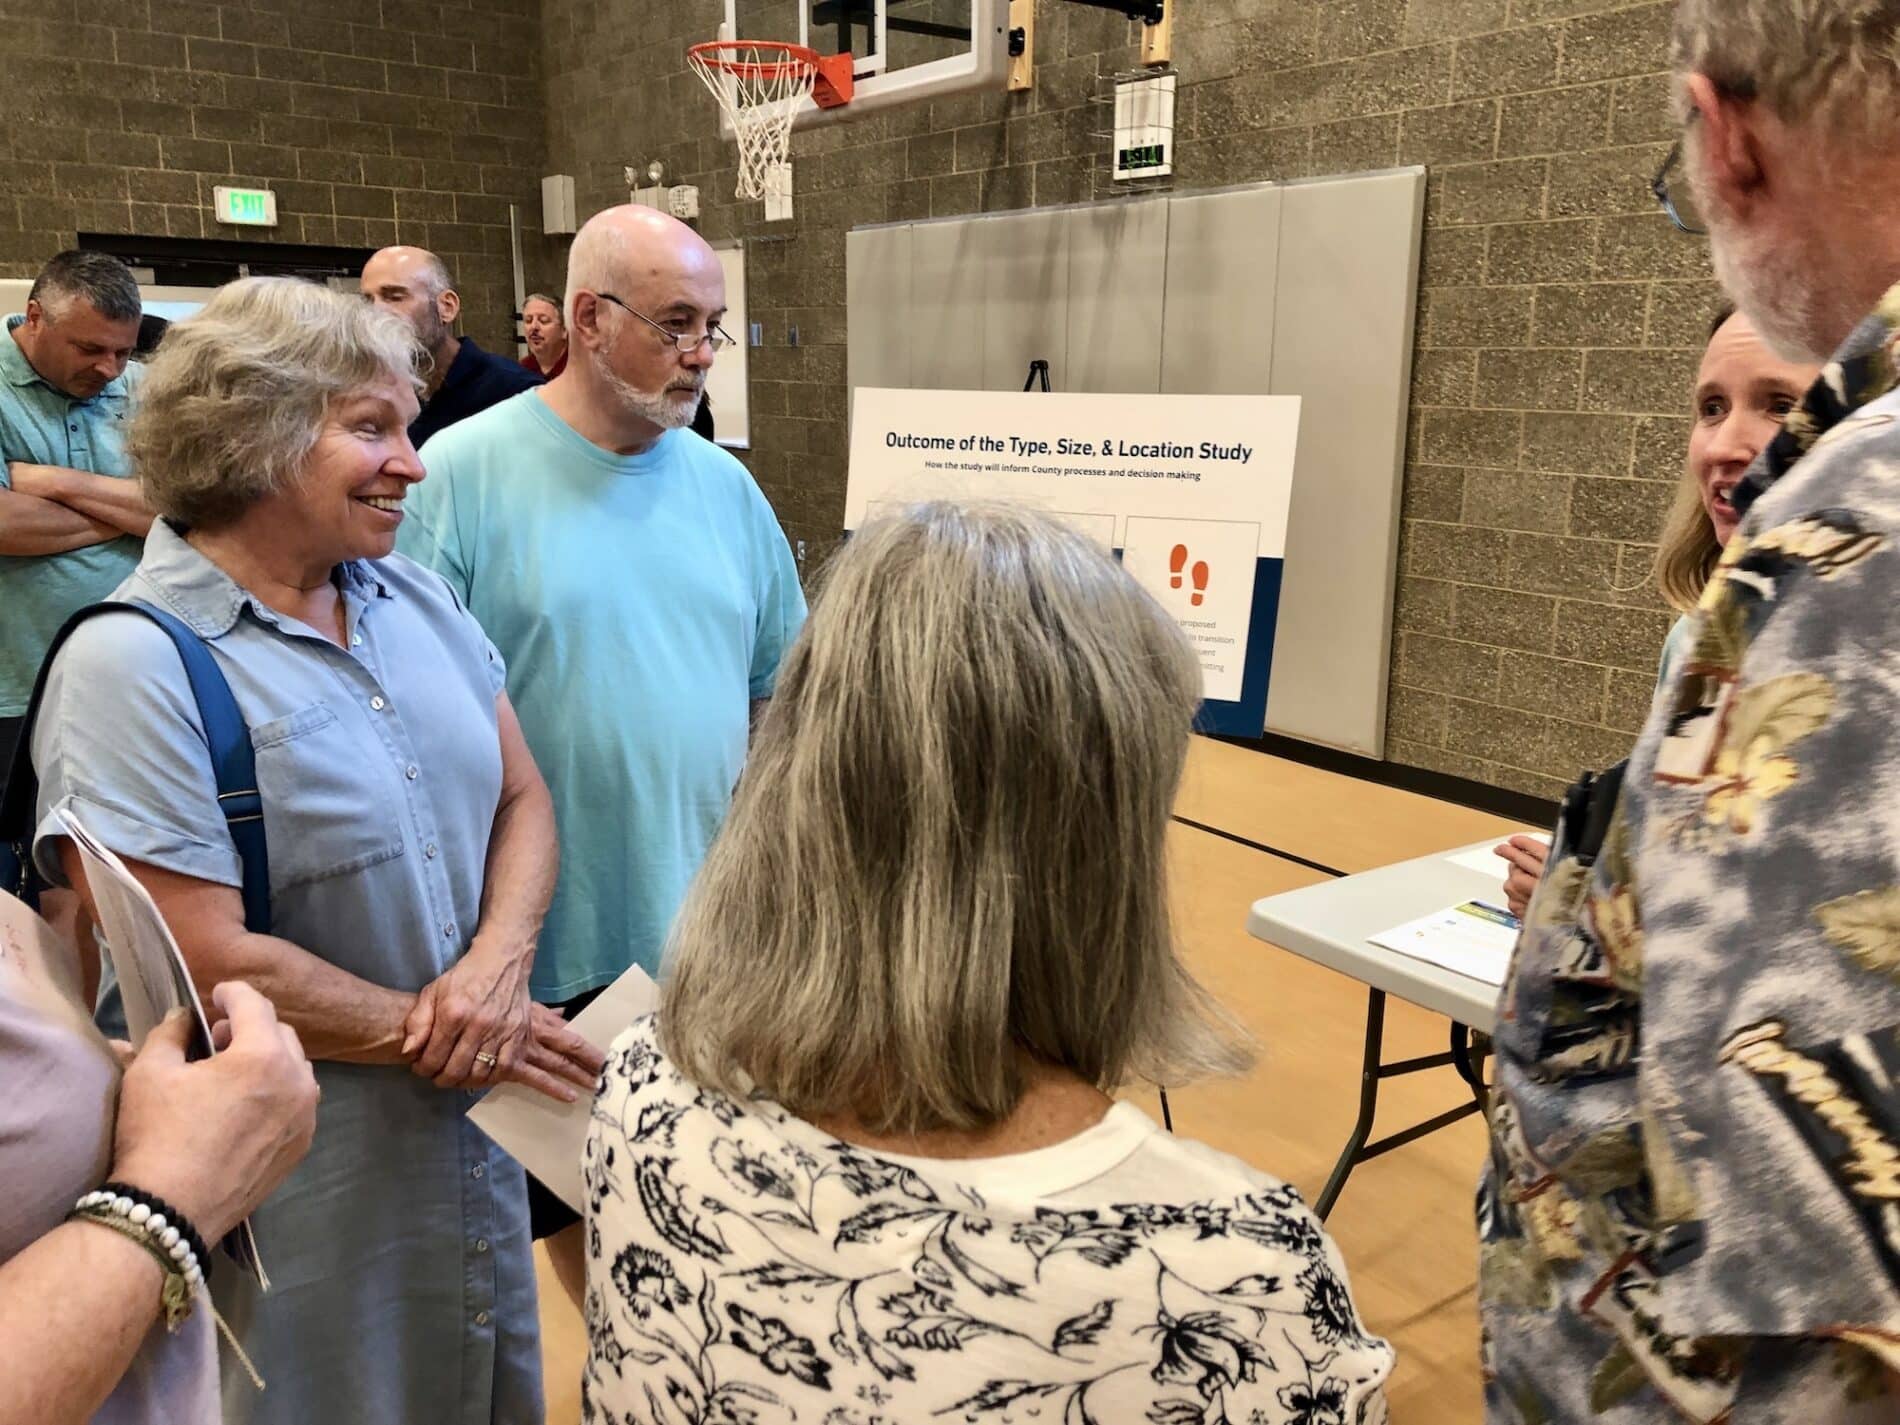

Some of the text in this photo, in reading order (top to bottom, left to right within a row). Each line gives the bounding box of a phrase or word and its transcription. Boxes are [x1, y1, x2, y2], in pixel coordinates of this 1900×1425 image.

[230, 191, 265, 219] EXIT
[886, 431, 1253, 464] Outcome of the Type, Size, & Location Study
[924, 460, 1201, 482] How the study will inform County processes and decision making
[1180, 618, 1216, 630] proposed
